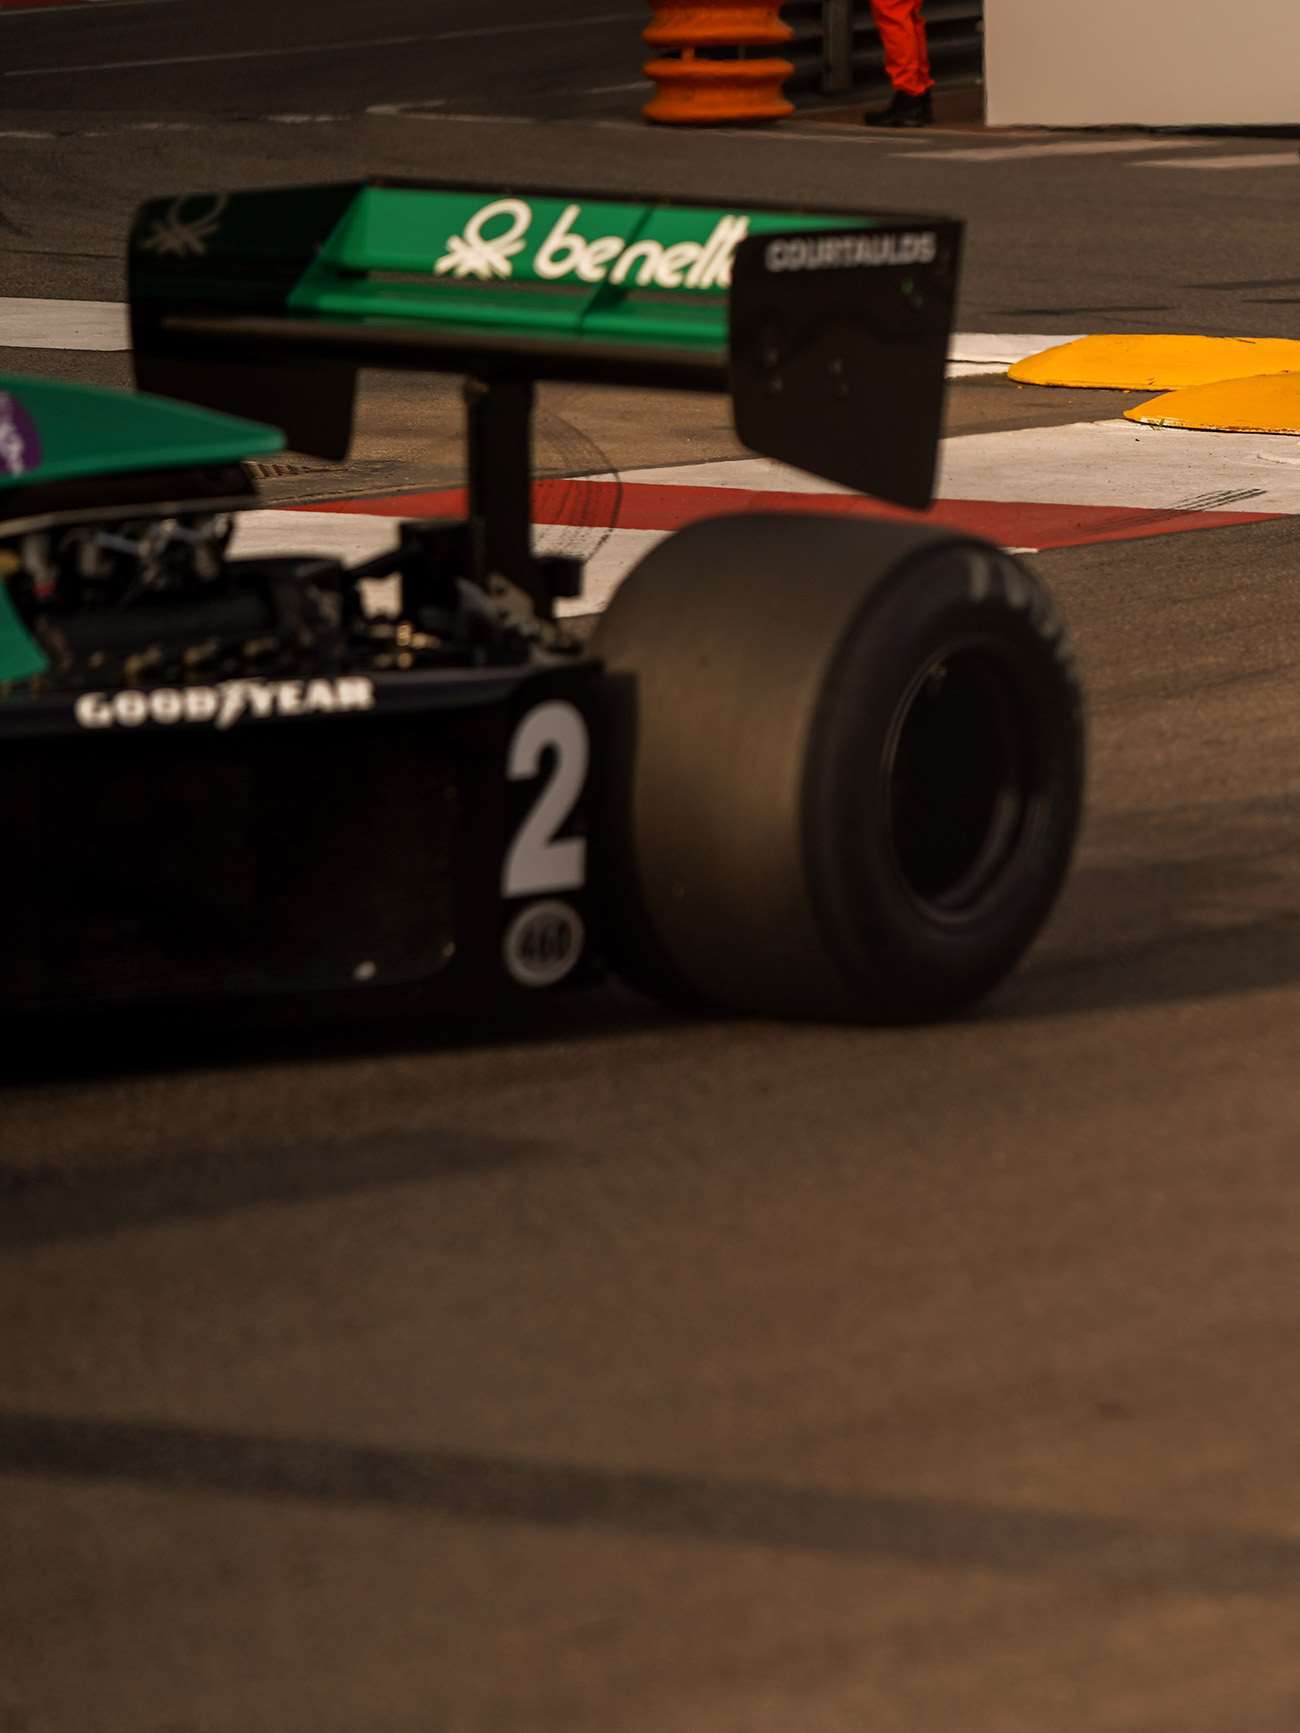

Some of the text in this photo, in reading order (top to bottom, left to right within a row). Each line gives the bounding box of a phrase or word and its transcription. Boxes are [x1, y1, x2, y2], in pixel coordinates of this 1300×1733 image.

[764, 232, 938, 273] COURTAULDS
[75, 676, 376, 731] GOODYEAR
[502, 699, 590, 899] 2
